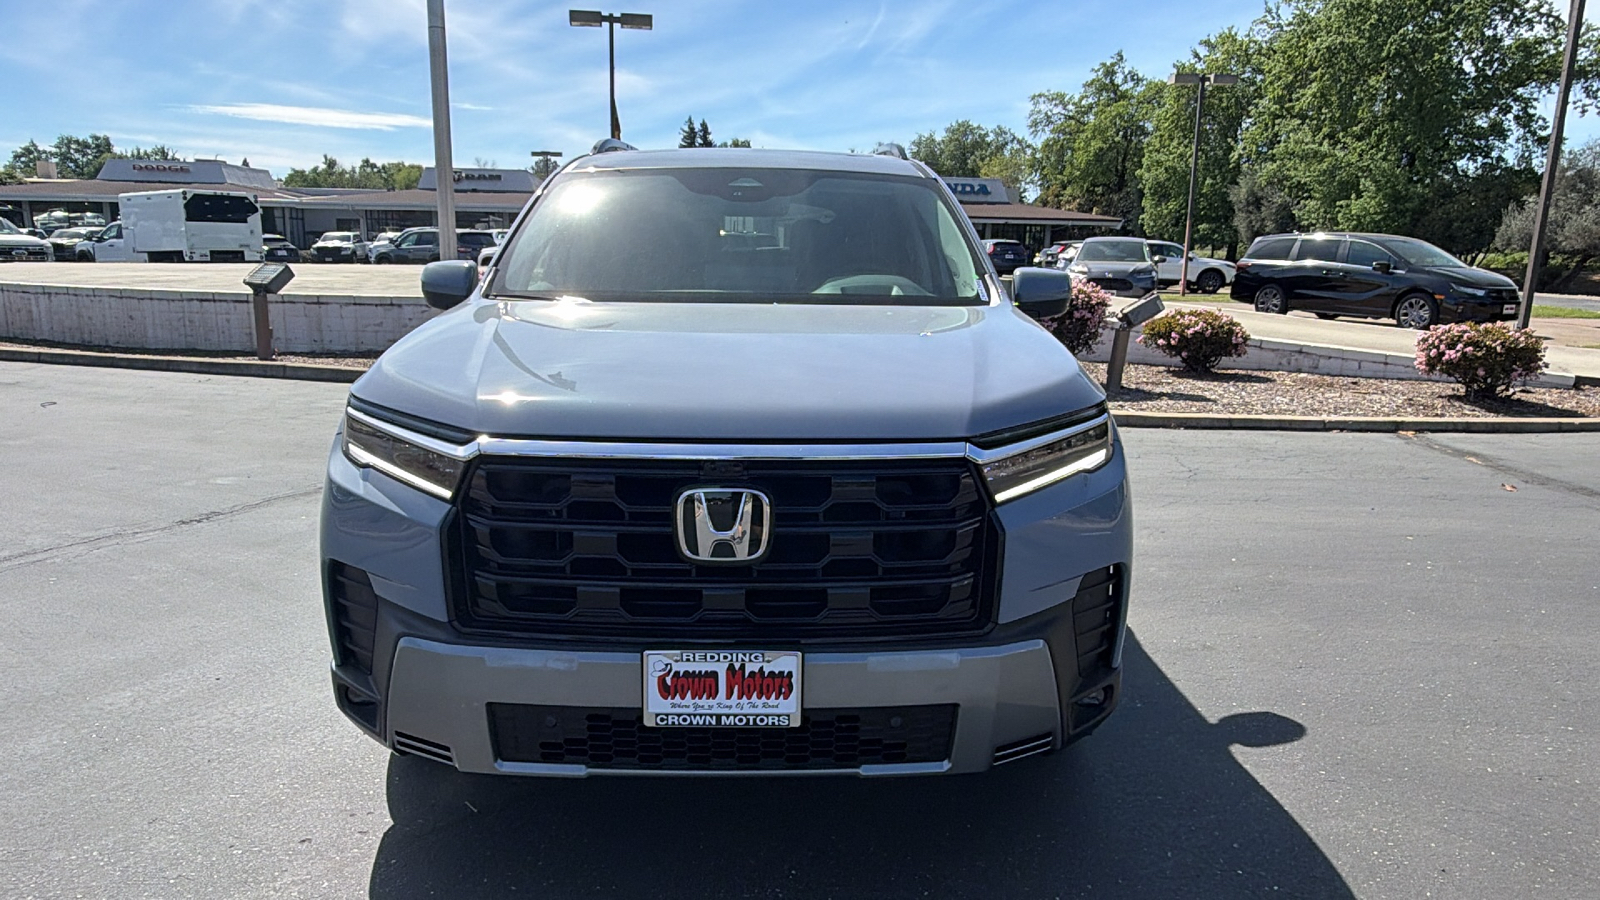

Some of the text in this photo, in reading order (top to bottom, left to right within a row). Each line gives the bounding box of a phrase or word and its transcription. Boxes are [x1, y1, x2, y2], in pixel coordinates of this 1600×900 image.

[132, 164, 191, 173] DODGE
[946, 183, 991, 195] NDA
[682, 653, 763, 662] REDDING
[657, 663, 793, 700] Crown Motors
[716, 702, 733, 711] King
[735, 702, 745, 711] Of
[656, 715, 789, 726] CROWN MOTORS
